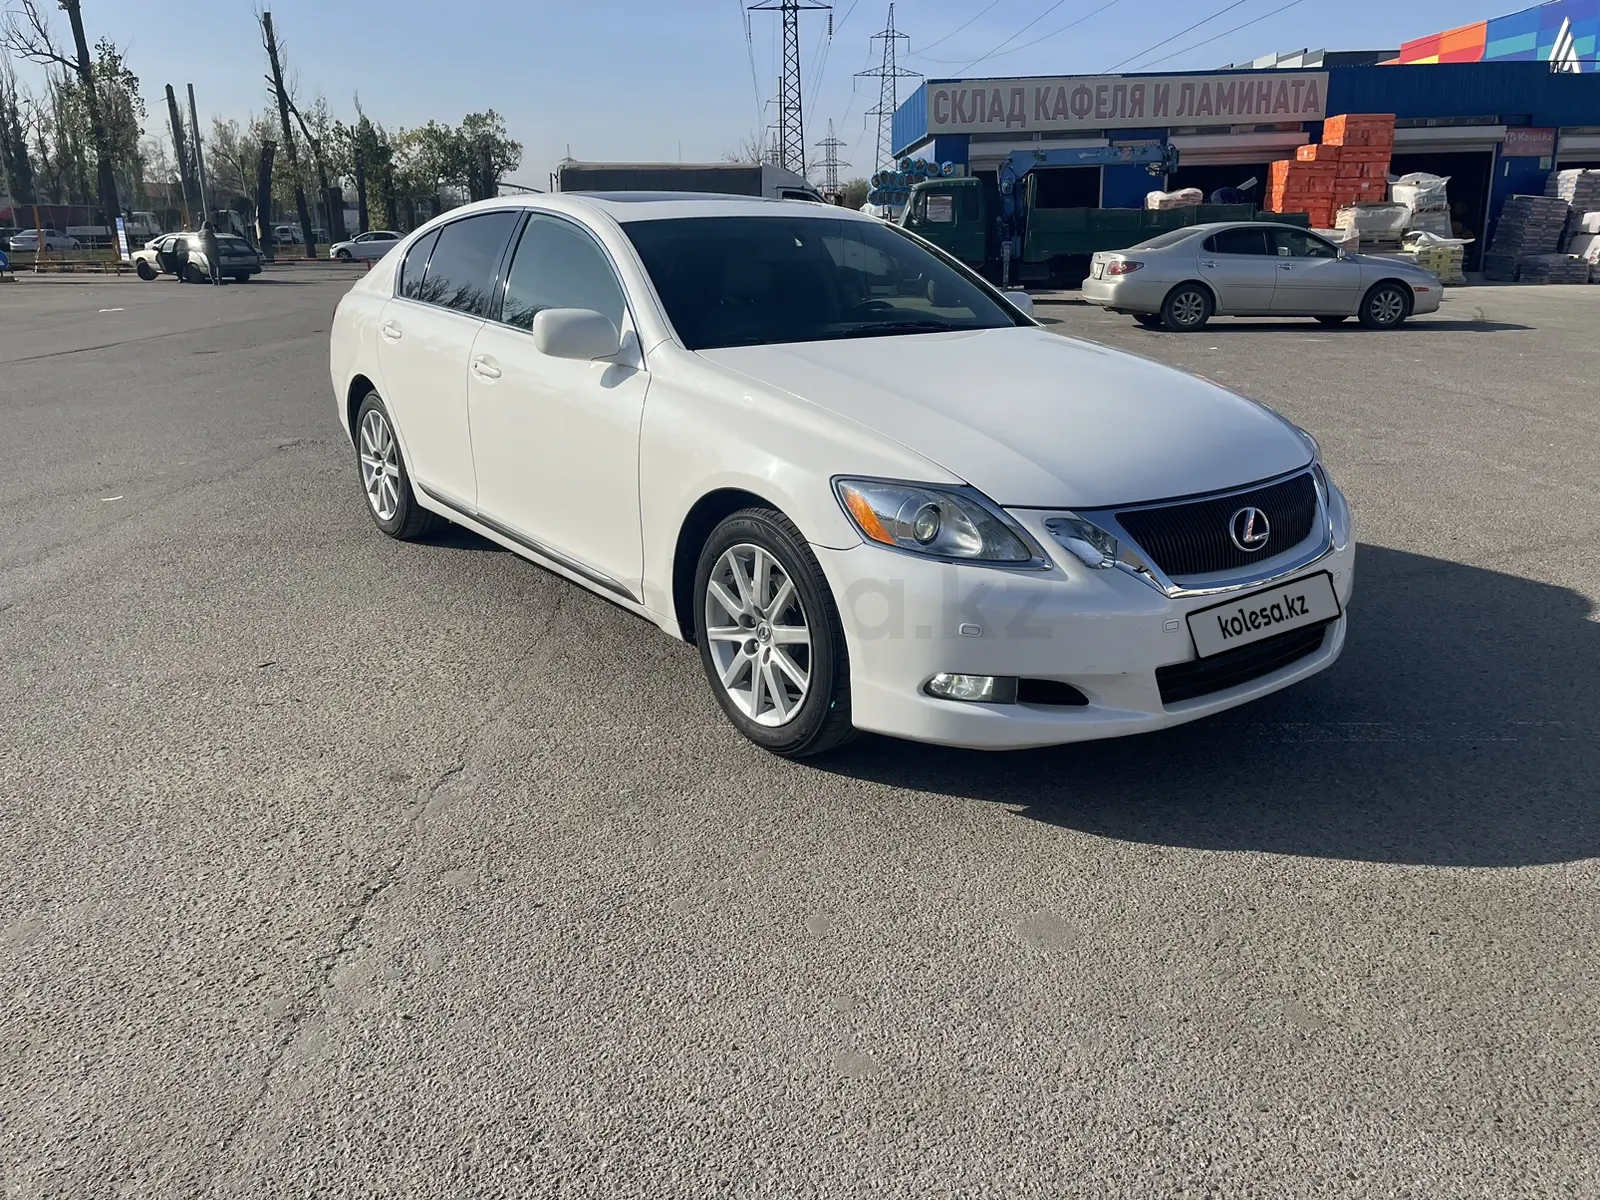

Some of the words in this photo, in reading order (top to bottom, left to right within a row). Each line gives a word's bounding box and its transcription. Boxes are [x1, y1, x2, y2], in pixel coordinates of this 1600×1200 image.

[933, 88, 1027, 128] СКЛАД
[1033, 84, 1145, 121] КАФЕЛЯ
[1152, 85, 1169, 118] И
[1175, 80, 1321, 117] ЛАМИНАТА
